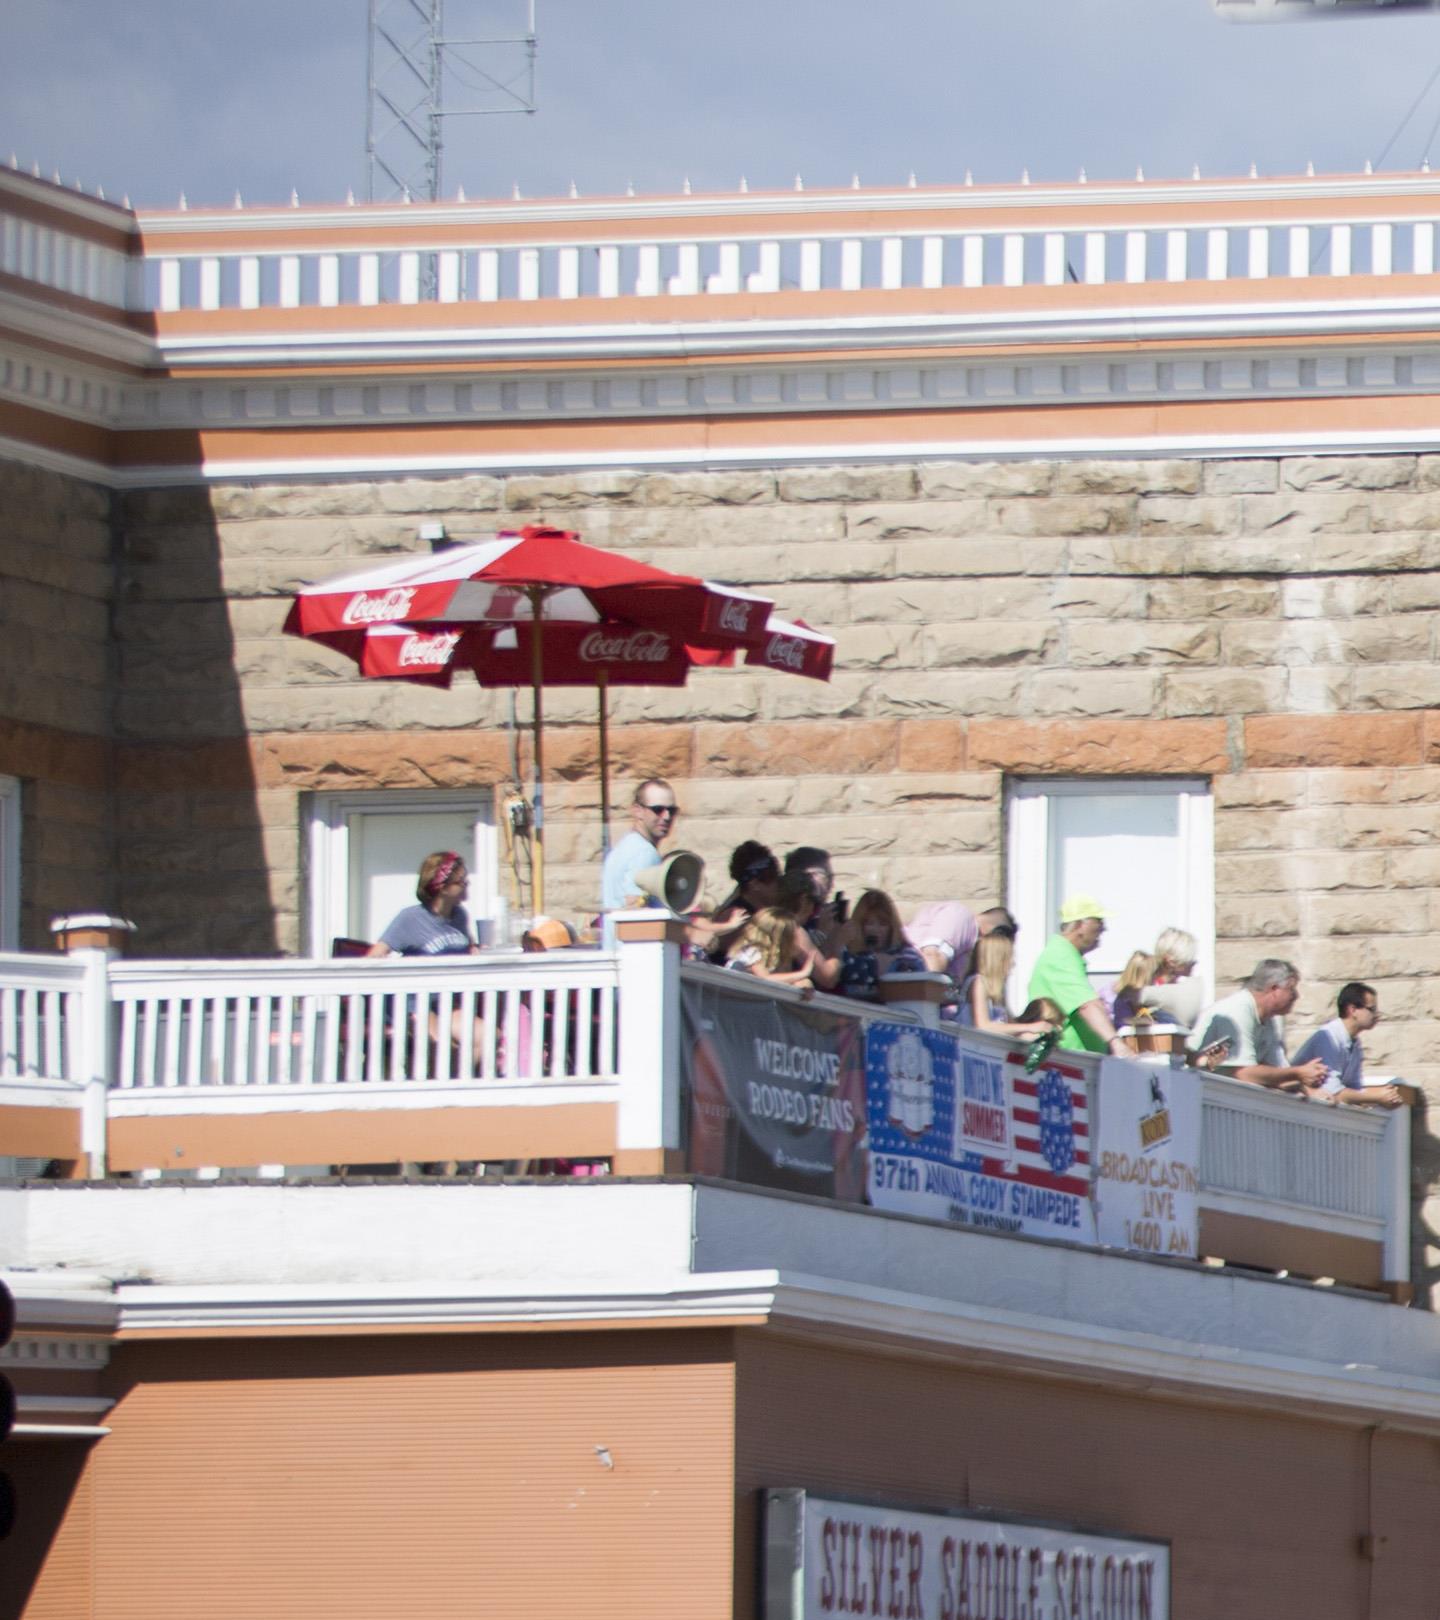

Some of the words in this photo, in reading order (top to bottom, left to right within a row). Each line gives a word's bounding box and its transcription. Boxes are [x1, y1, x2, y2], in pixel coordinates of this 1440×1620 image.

[754, 1037, 841, 1085] WELCOME
[748, 1080, 808, 1124] RODEO
[808, 1094, 855, 1133] FANS
[874, 1155, 919, 1192] 97th
[970, 1175, 1008, 1214] CODY
[1011, 1184, 1080, 1228] STAMPEDE
[1142, 1190, 1176, 1221] LIVE
[1125, 1219, 1161, 1251] 1400
[1167, 1228, 1191, 1252] AM
[821, 1517, 924, 1620] SILVER
